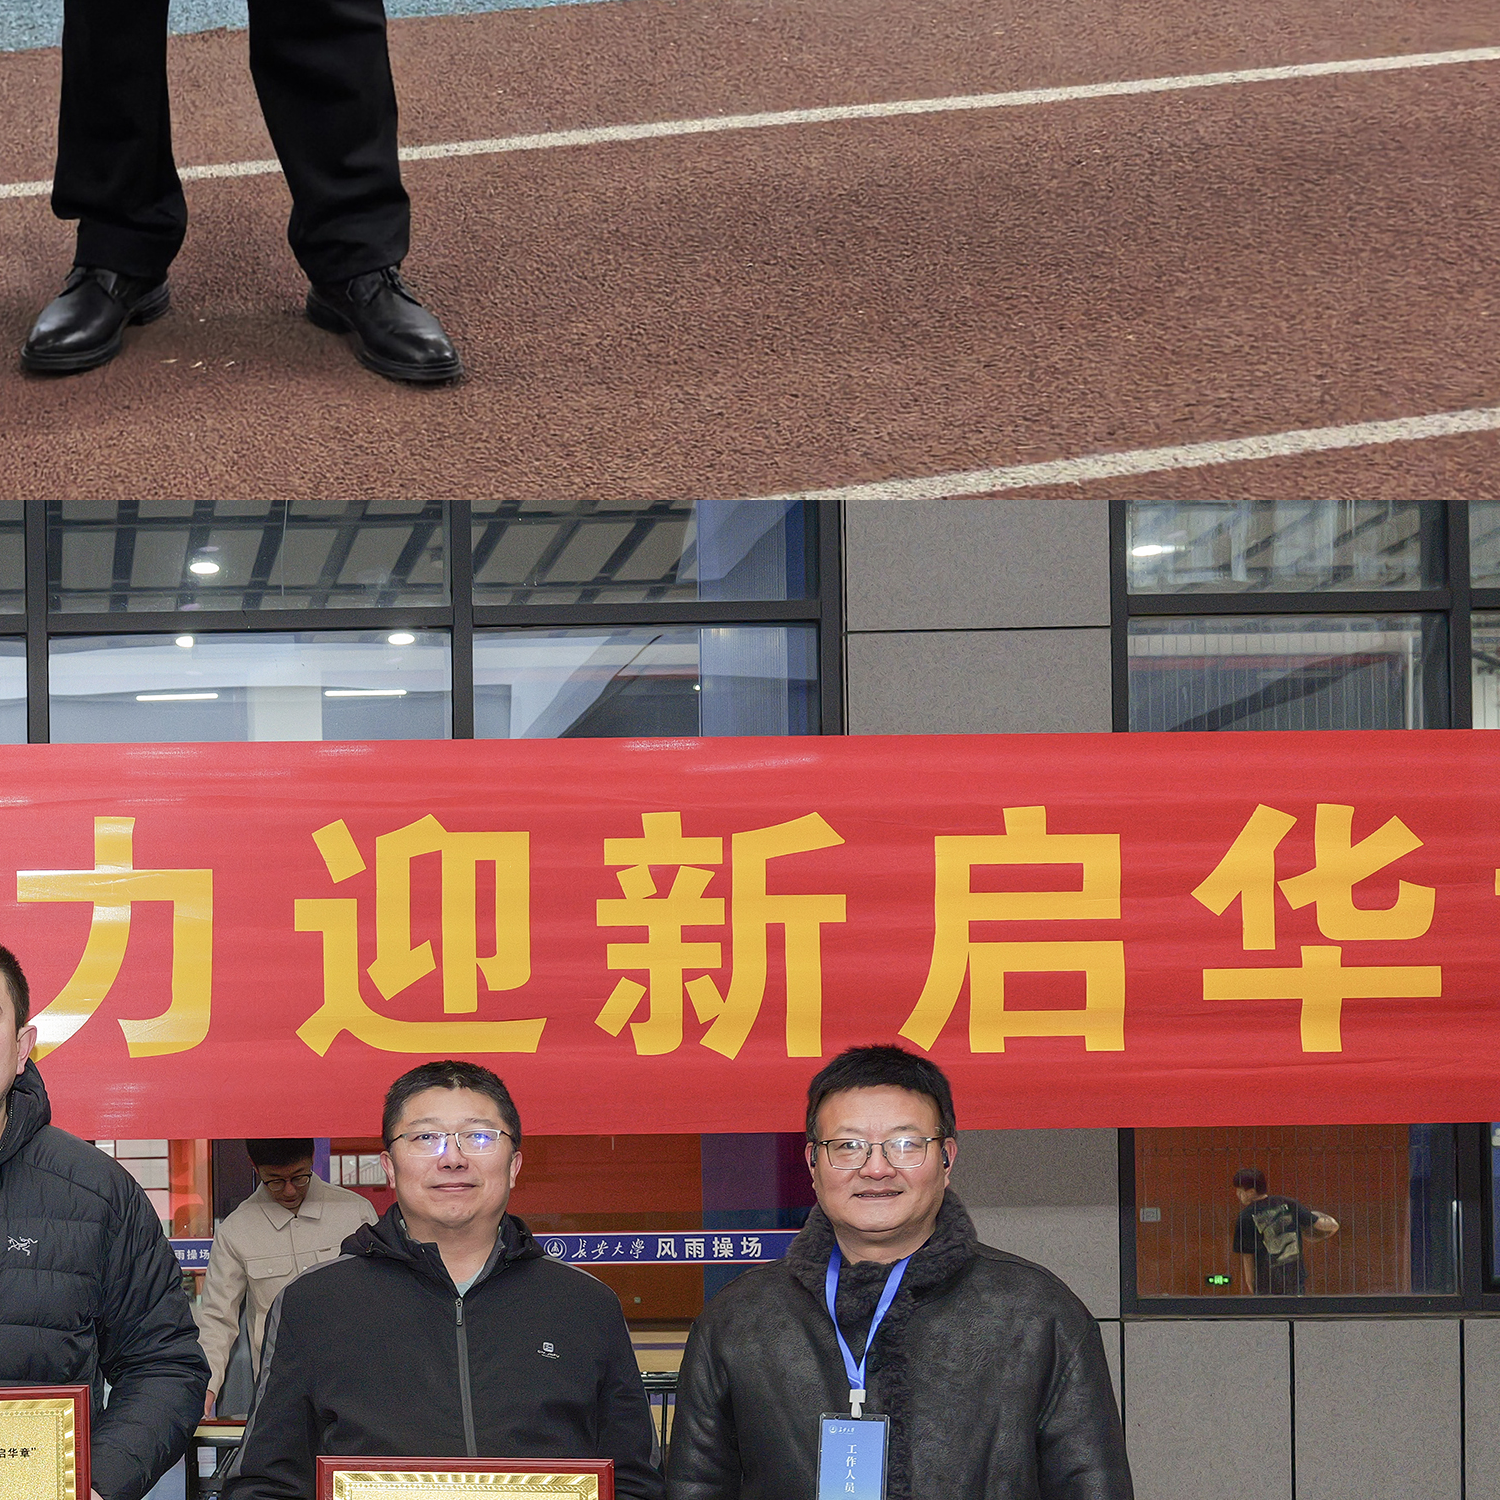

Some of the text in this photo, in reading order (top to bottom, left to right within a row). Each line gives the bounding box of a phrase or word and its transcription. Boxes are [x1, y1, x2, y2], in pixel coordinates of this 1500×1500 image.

[656, 1236, 762, 1259] 风雨操场
[845, 1444, 857, 1493] 工作人员
